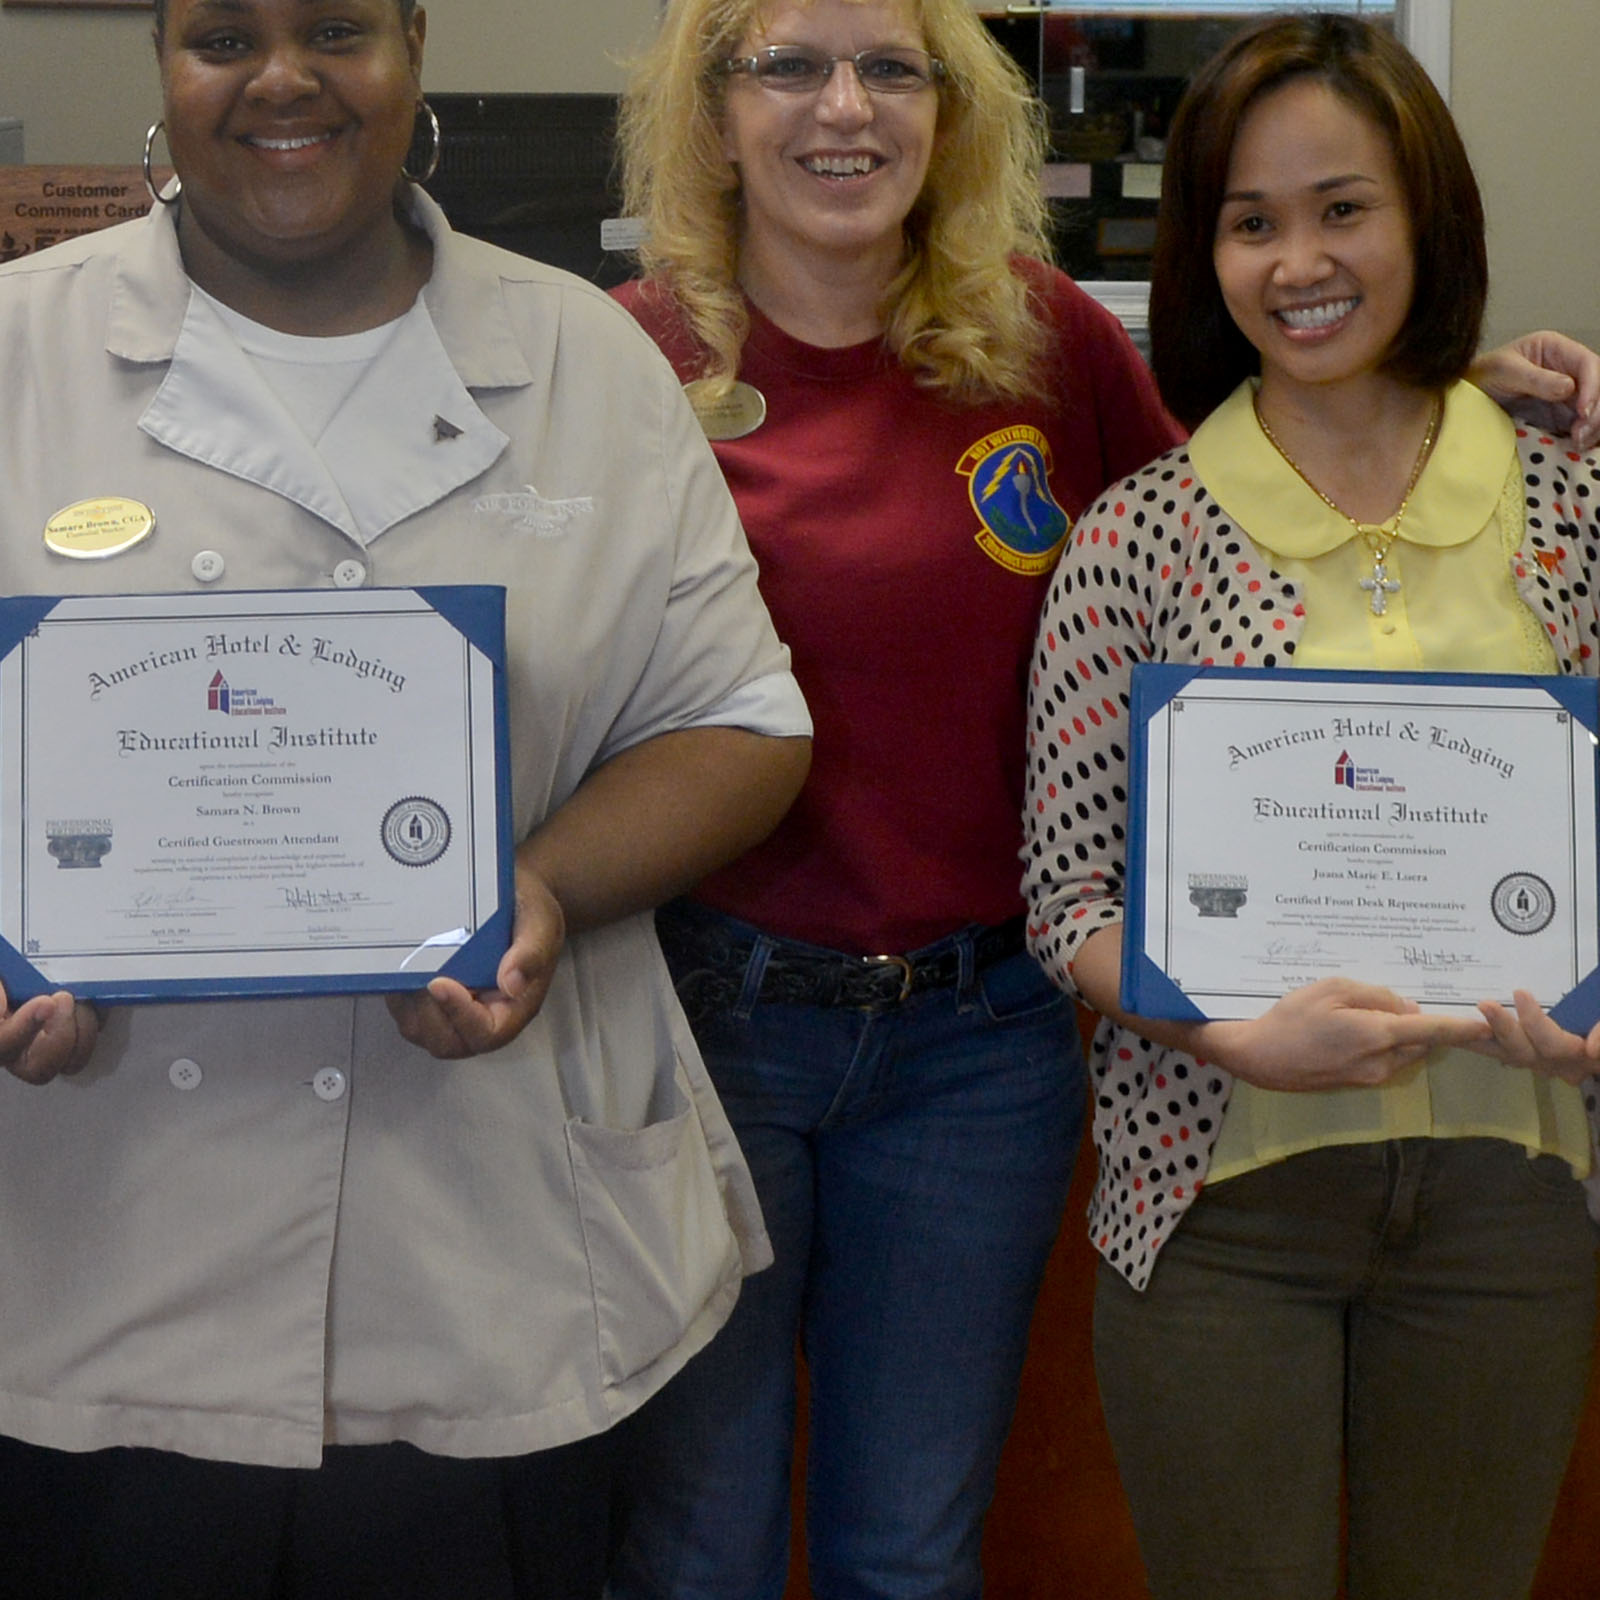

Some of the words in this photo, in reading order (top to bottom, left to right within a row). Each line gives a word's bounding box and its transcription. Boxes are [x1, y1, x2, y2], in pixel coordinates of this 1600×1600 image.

[42, 183, 128, 198] Customer
[15, 203, 99, 218] Comment
[88, 647, 197, 700] American
[204, 634, 269, 662] Hotel
[279, 634, 302, 656] &
[310, 637, 406, 693] Lodging
[116, 728, 259, 758] Educational
[267, 726, 378, 754] Institute
[1227, 727, 1325, 771] American
[1331, 718, 1391, 743] Hotel
[1399, 721, 1420, 741] &
[1427, 726, 1516, 779] Lodging
[168, 774, 247, 788] Certification
[251, 773, 332, 786] Commission
[196, 805, 240, 817] Samara
[243, 804, 258, 816] N.
[262, 804, 300, 815] Brown
[1253, 797, 1380, 823] Educational
[1388, 802, 1488, 826] Institute
[158, 835, 209, 848] Certified
[213, 835, 277, 847] Guestroom
[282, 834, 340, 846] Attendant
[1298, 841, 1370, 854] Certification
[1374, 843, 1447, 856] Commission
[1350, 870, 1377, 880] Marie
[1382, 871, 1393, 881] E.
[1275, 894, 1321, 906] Certified
[1325, 895, 1353, 907] Front
[1357, 897, 1385, 909] Desk
[1388, 899, 1466, 912] Representative
